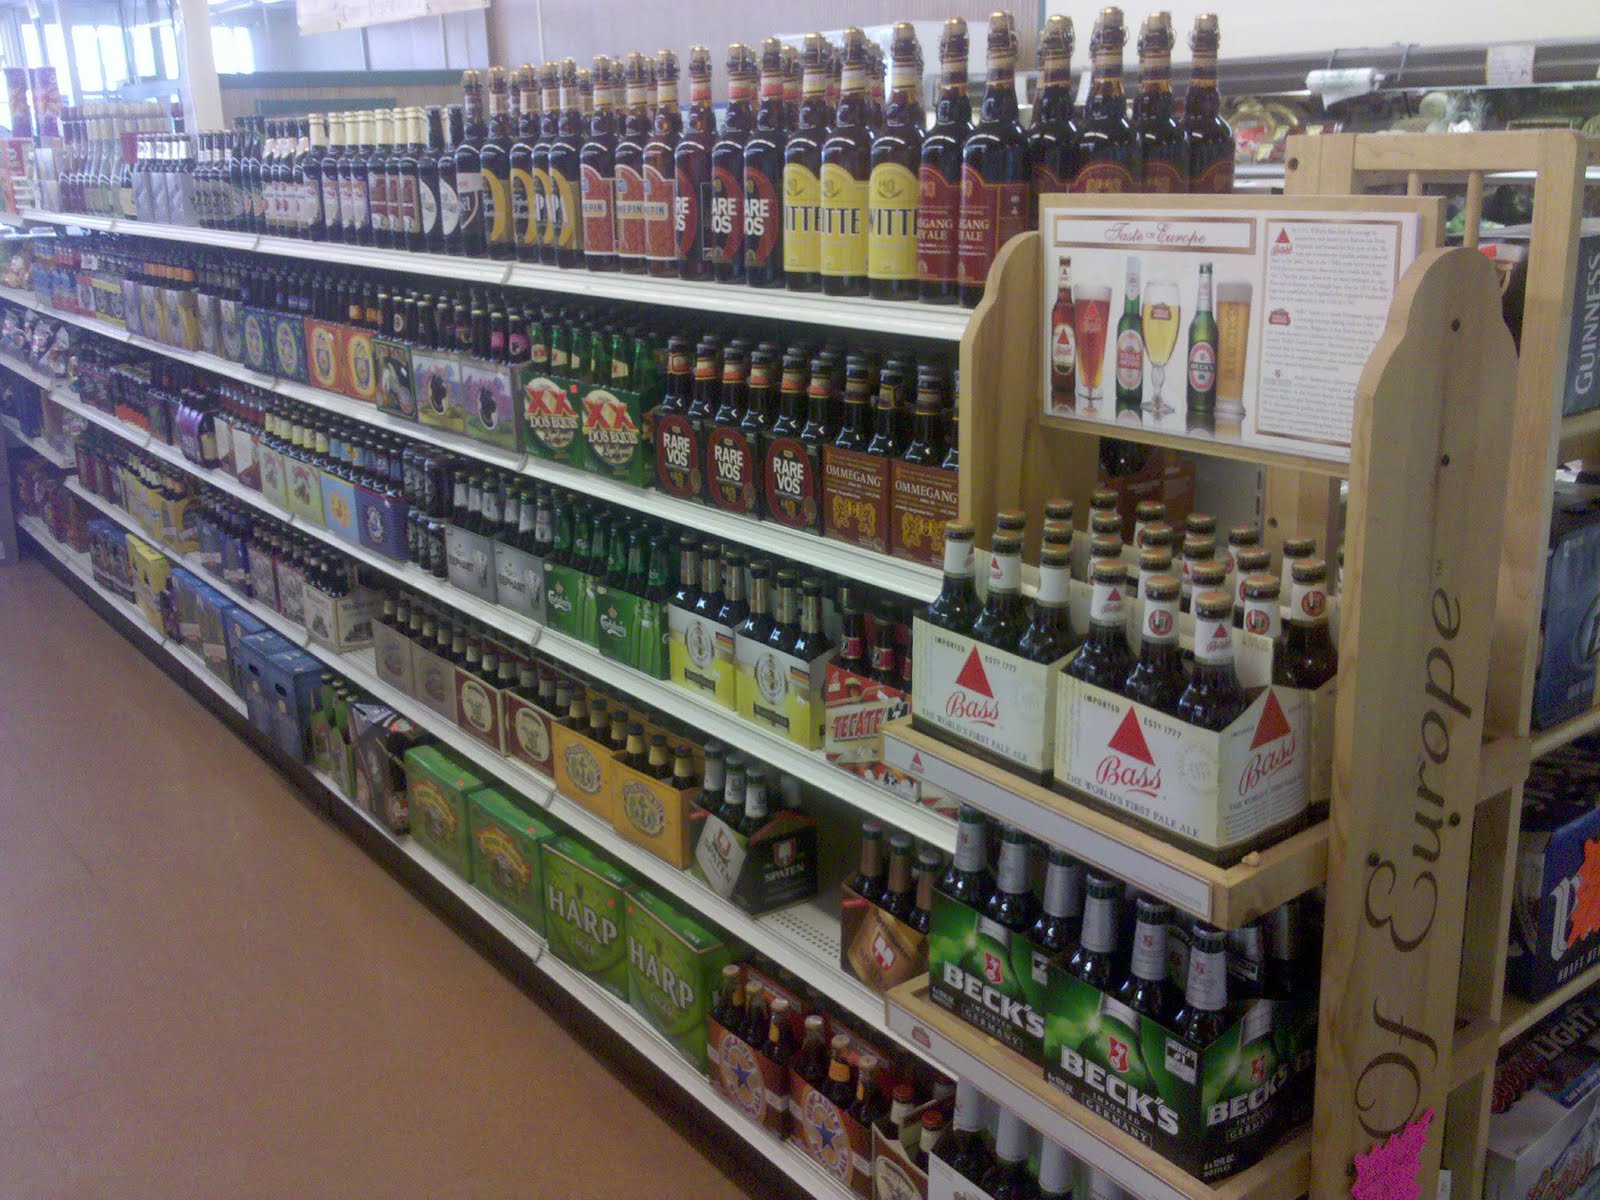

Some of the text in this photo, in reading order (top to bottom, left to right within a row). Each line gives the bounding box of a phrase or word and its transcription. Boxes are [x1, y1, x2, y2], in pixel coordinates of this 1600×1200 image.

[1104, 222, 1143, 243] Taste
[1156, 223, 1206, 246] Europe
[1575, 253, 1600, 395] GUINNESS
[525, 386, 577, 416] XX
[582, 398, 639, 432] XX
[530, 416, 578, 429] DOS EQUIS
[589, 431, 638, 444] DOS EQUIS
[663, 432, 690, 453] RARE
[666, 447, 688, 467] VOS
[715, 445, 744, 467] RARE
[718, 462, 741, 481] VOS
[773, 457, 803, 480] RARE
[776, 474, 800, 494] VOS
[826, 464, 881, 487] OMMEGANG
[895, 480, 957, 503] OMMEGANG
[934, 636, 965, 653] IMPORTED
[946, 690, 999, 722] Bass
[1084, 693, 1120, 713] IMPORTED
[1164, 727, 1182, 739] 1777
[833, 707, 884, 738] TECATE
[923, 707, 1028, 762] THE WORLD'S FIRST PALE ALE
[1096, 755, 1161, 794] Bass
[1239, 730, 1296, 796] Bass
[1365, 588, 1472, 951] Europe
[1067, 773, 1199, 837] THE WORLD'S FIRST PALE ALE
[765, 863, 804, 881] SPATEN
[549, 884, 617, 944] HARP
[629, 936, 694, 1008] HARP
[944, 961, 1045, 1038] BECK'S
[1354, 994, 1438, 1139] Of
[1061, 1044, 1179, 1135] BECK'S
[1086, 1099, 1147, 1142] GERMANY
[1093, 1092, 1141, 1125] IMPORTED
